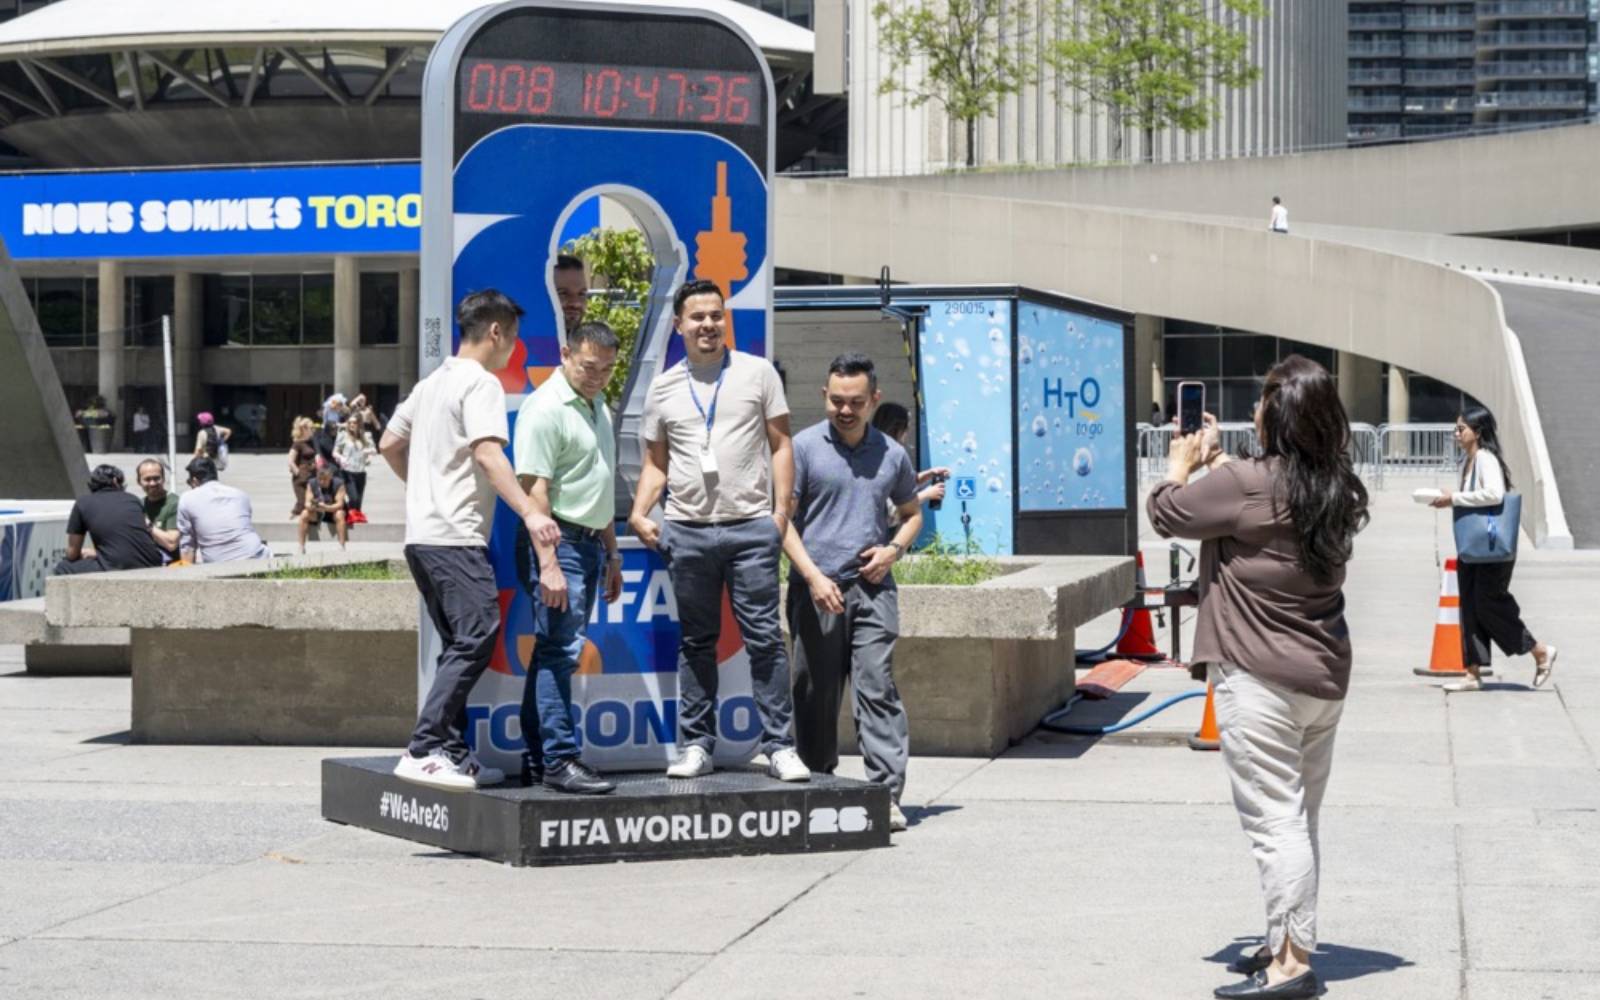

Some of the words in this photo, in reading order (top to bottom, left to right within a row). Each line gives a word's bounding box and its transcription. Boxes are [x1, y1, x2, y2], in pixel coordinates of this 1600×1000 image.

[468, 63, 556, 114] 008
[582, 69, 751, 124] 10:47:36
[23, 202, 134, 235] NOUS
[140, 197, 301, 232] SOMMES
[944, 302, 985, 315] 290015
[380, 791, 449, 832] #WeAre26
[540, 818, 610, 848] FIFA
[616, 813, 732, 844] WORLD
[739, 810, 801, 838] CUP
[808, 806, 868, 834] 26
